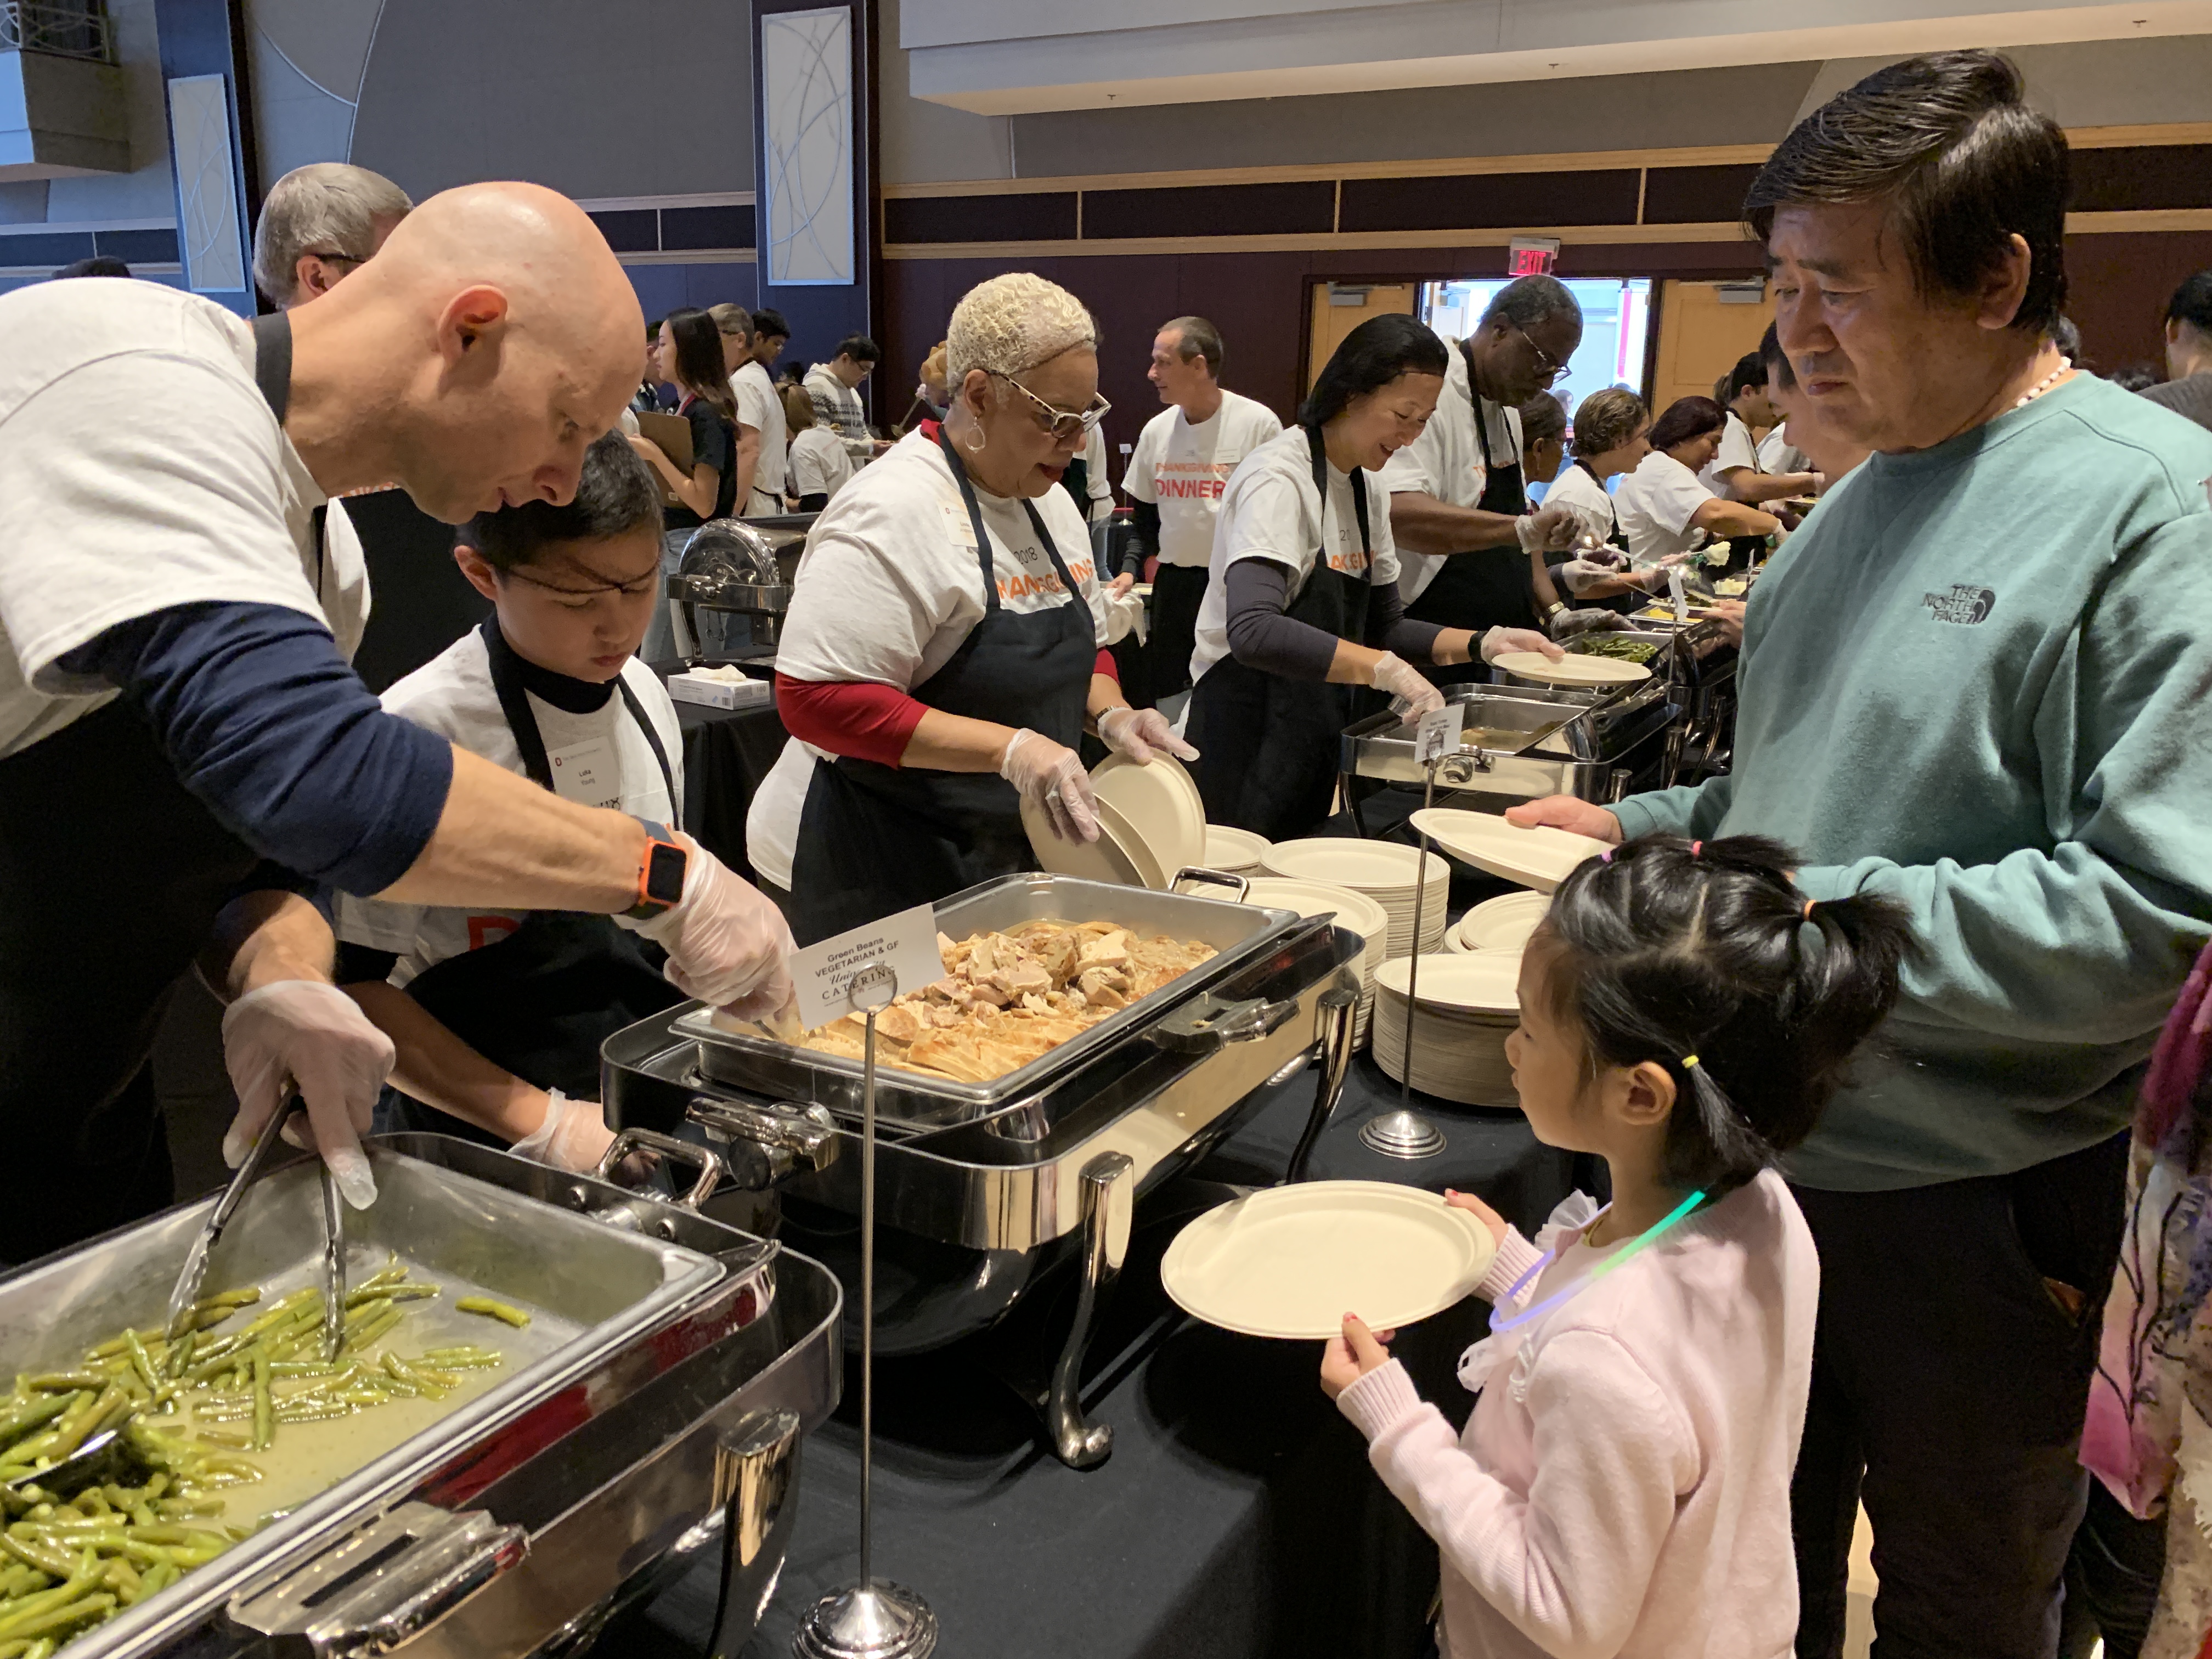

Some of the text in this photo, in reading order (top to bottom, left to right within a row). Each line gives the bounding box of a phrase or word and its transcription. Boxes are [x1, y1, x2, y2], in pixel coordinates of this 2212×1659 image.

[1516, 251, 1546, 274] EXIT
[1155, 478, 1226, 499] DINNER
[1014, 546, 1038, 565] 2018
[1951, 584, 1979, 599] THE
[1921, 592, 1975, 612] NORTH
[1931, 610, 1971, 624] FACE
[815, 950, 875, 978] VEGETARIAN
[887, 940, 899, 951] GF
[827, 938, 884, 962] Green Beans
